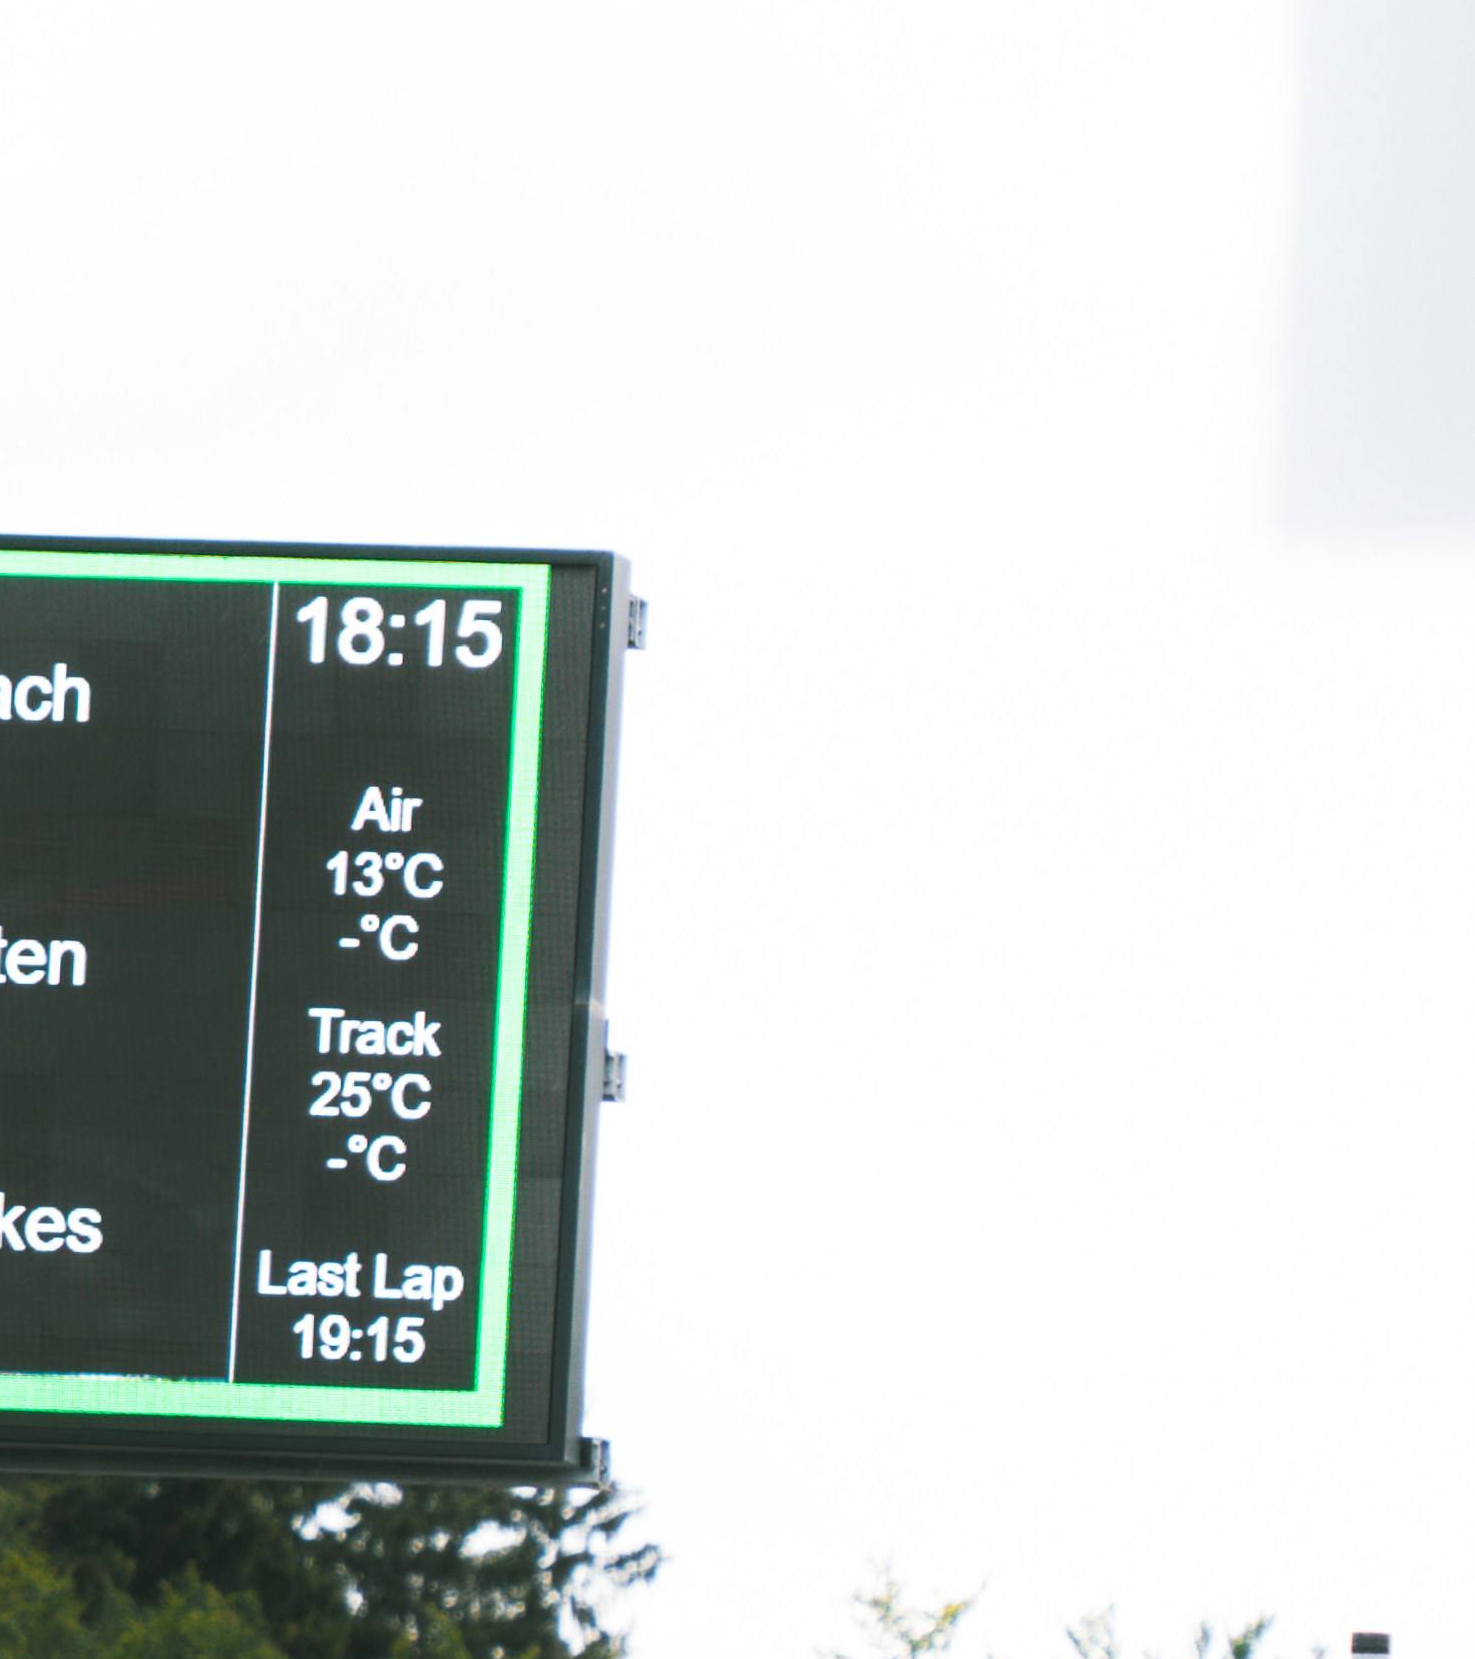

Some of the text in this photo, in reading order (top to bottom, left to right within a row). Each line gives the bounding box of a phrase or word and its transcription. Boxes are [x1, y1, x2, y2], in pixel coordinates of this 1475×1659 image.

[296, 595, 503, 669] 18:15
[350, 786, 423, 833] Air
[326, 850, 444, 899] 13°C
[338, 913, 420, 961] -°C
[308, 1007, 442, 1058] Track
[308, 1070, 432, 1120] 25°C
[326, 1134, 407, 1182] -°C
[257, 1249, 464, 1308] Last Lap
[293, 1313, 426, 1363] 19:15
